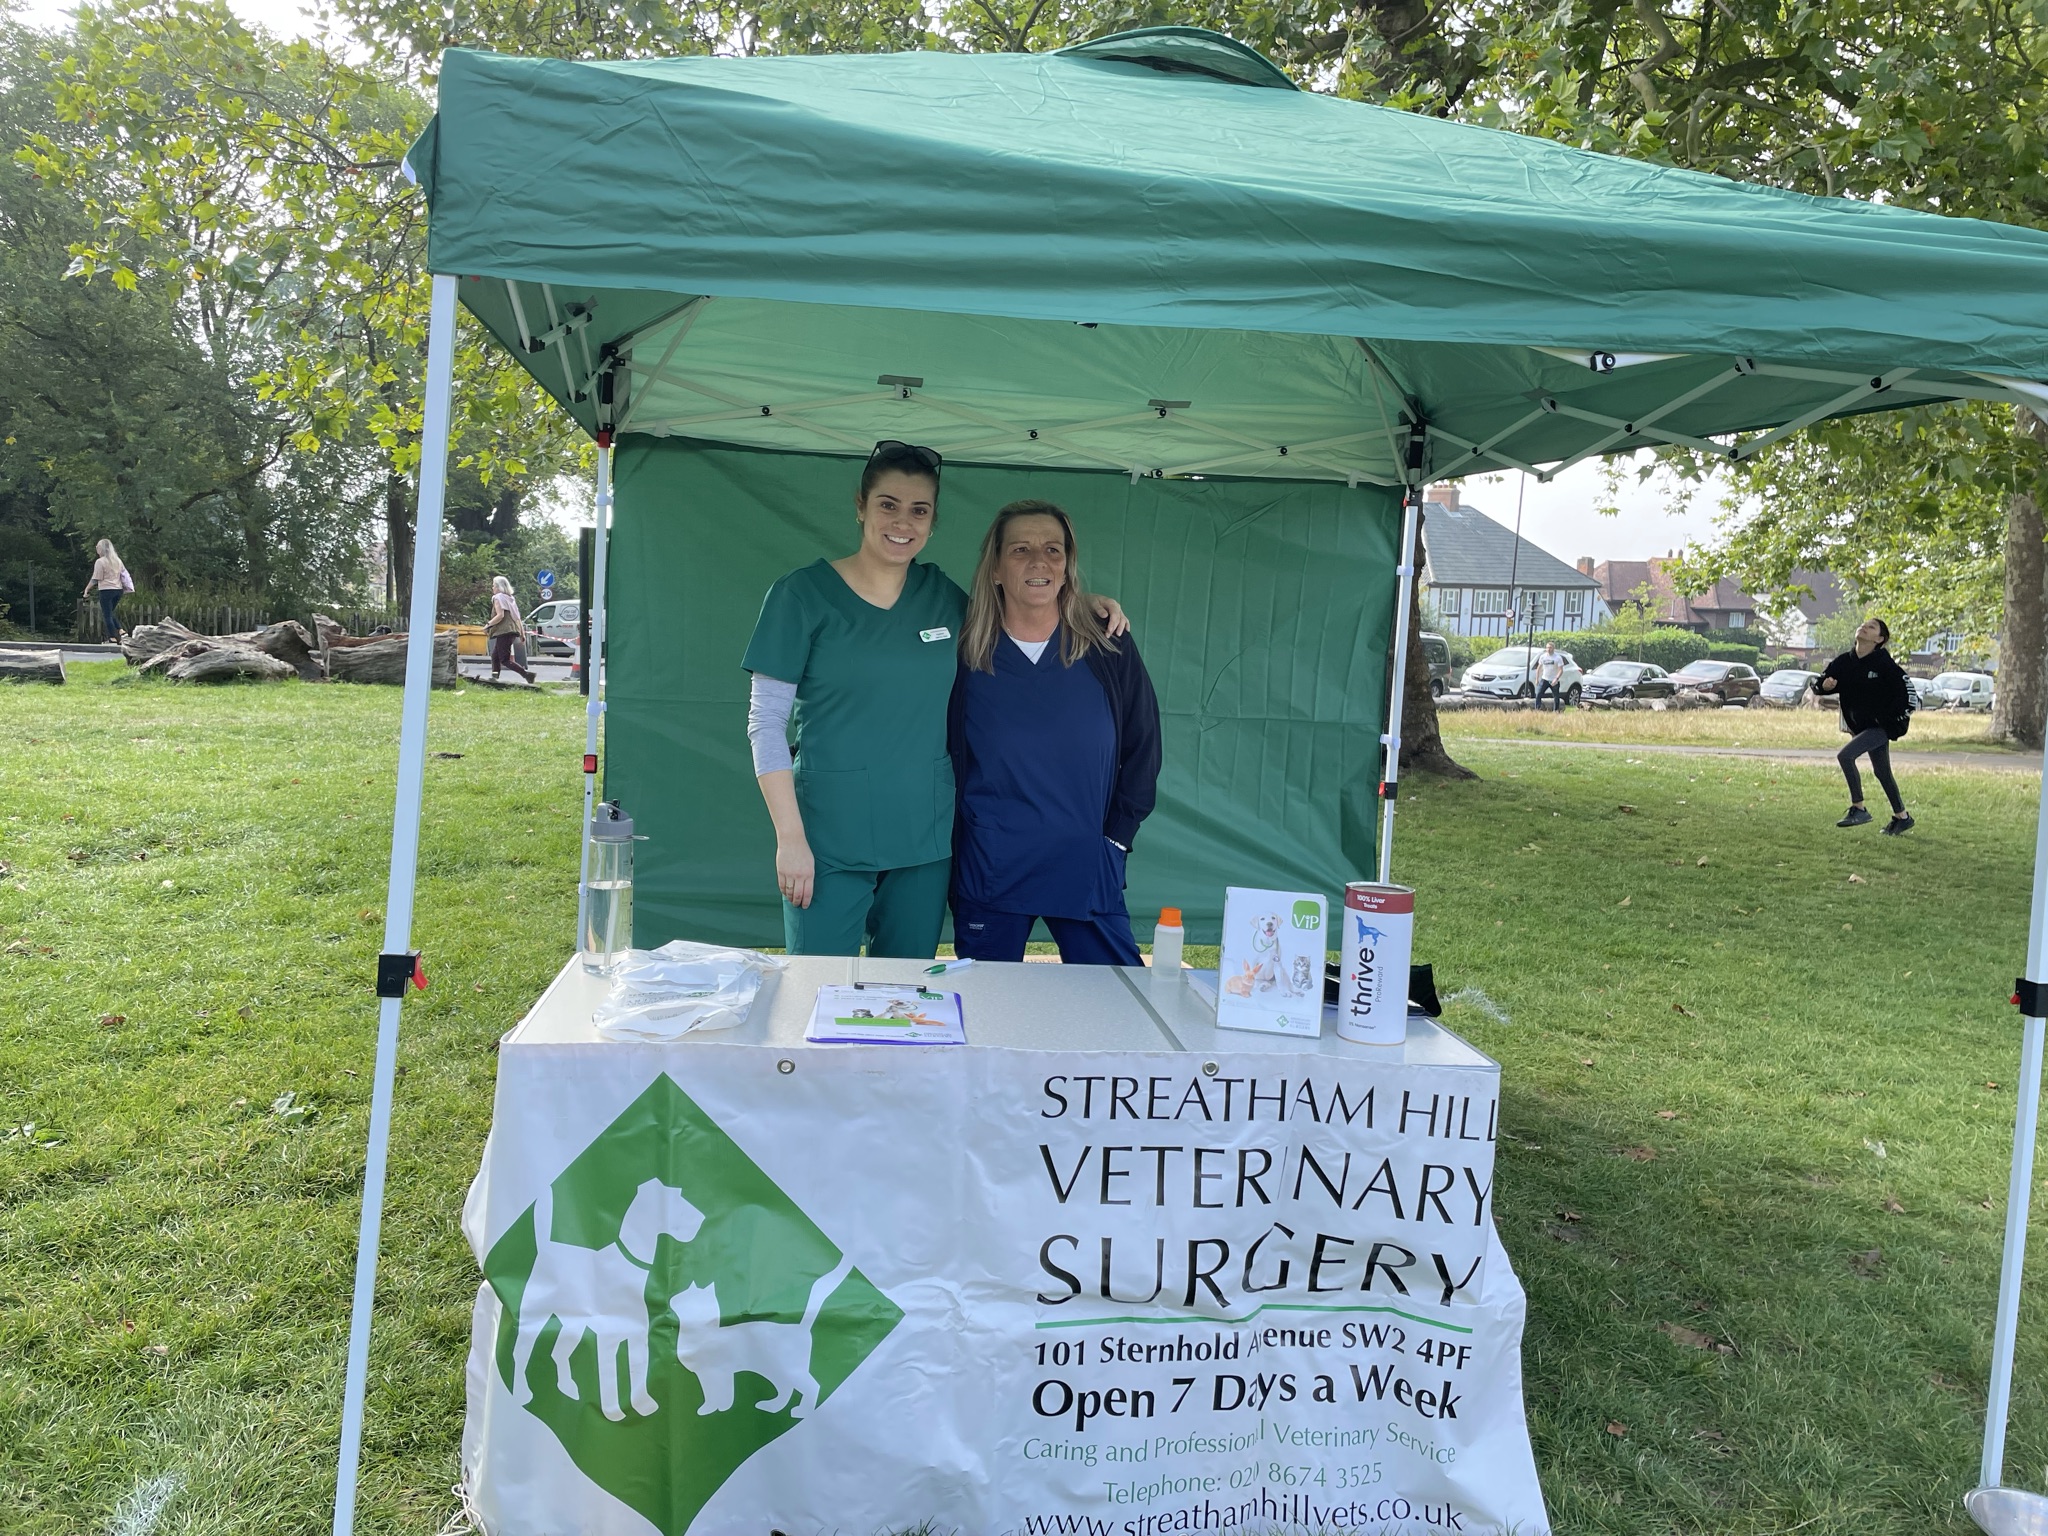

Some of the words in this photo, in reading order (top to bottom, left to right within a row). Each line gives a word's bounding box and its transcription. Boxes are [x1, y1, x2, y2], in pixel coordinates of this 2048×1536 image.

[1356, 894, 1371, 903] 100%
[1371, 896, 1386, 904] Liver
[1350, 947, 1375, 1017] thrive
[1374, 966, 1384, 1003] ProReward
[1040, 1075, 1375, 1129] STREATHAM
[1398, 1090, 1497, 1142] HILL
[1038, 1143, 1494, 1227] VETERINARY
[1036, 1221, 1483, 1308] SURGERY
[1034, 1339, 1085, 1367] 101
[1099, 1331, 1240, 1364] Sternhold
[1247, 1326, 1332, 1358] Aenue
[1341, 1322, 1407, 1355] SW2
[1416, 1338, 1473, 1370] 4PF
[1031, 1379, 1156, 1432] Open
[1169, 1377, 1197, 1414] 7
[1212, 1372, 1297, 1412] Days
[1312, 1374, 1337, 1403] a
[1349, 1363, 1463, 1420] Week
[1022, 1438, 1098, 1468] Caring
[1105, 1439, 1148, 1462] and
[1154, 1417, 1265, 1459] Professionl
[1272, 1422, 1380, 1450] Veterinary
[1386, 1422, 1456, 1464] Service
[1103, 1473, 1222, 1506] Telephone:
[1229, 1460, 1260, 1489] 020
[1268, 1462, 1327, 1488] 8674
[1336, 1462, 1383, 1489] 3525
[1025, 1486, 1463, 1536] wwwstreathamhillvets.co.uk
